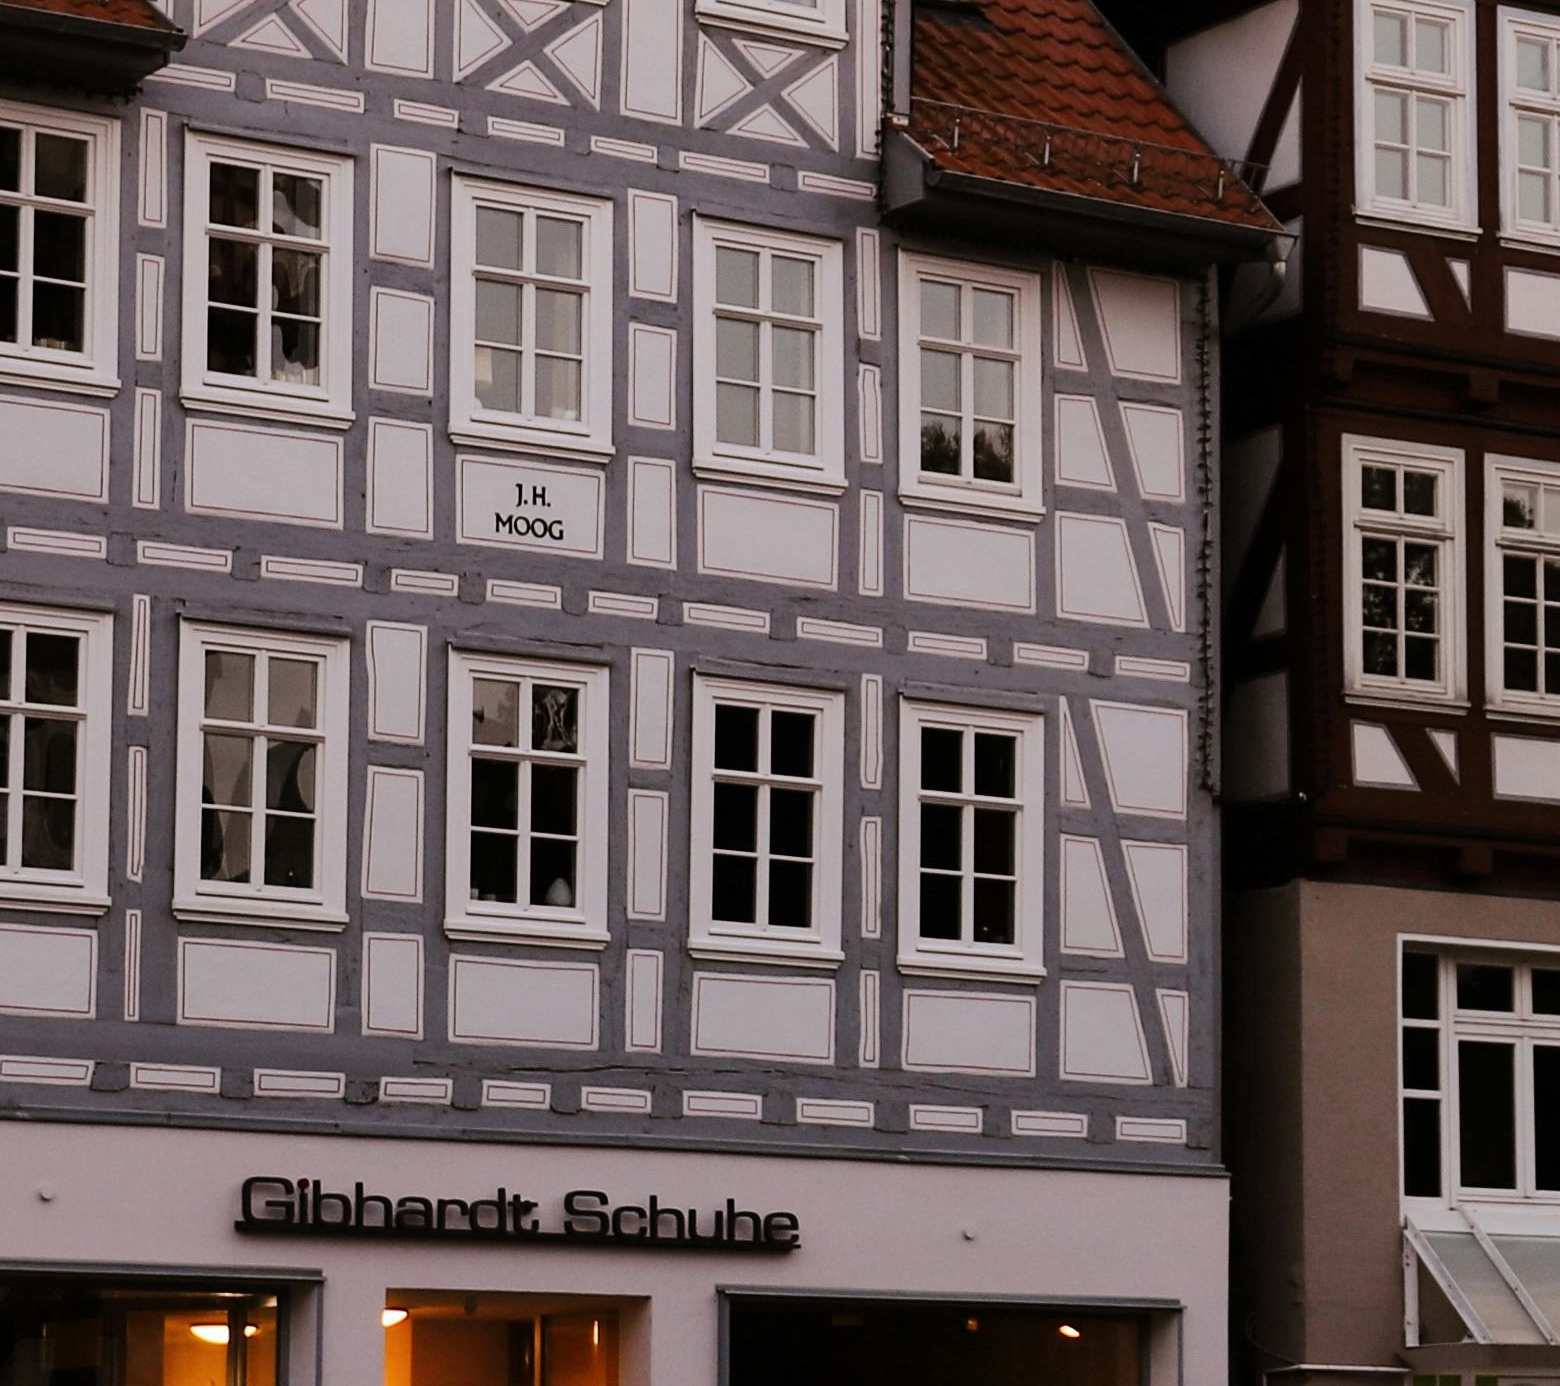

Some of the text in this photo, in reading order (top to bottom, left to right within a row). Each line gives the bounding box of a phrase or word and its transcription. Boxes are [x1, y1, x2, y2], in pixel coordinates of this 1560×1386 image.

[515, 483, 551, 507] J. H.
[495, 512, 564, 540] MOOG
[241, 1176, 800, 1246] Gibhardt Schuhe
